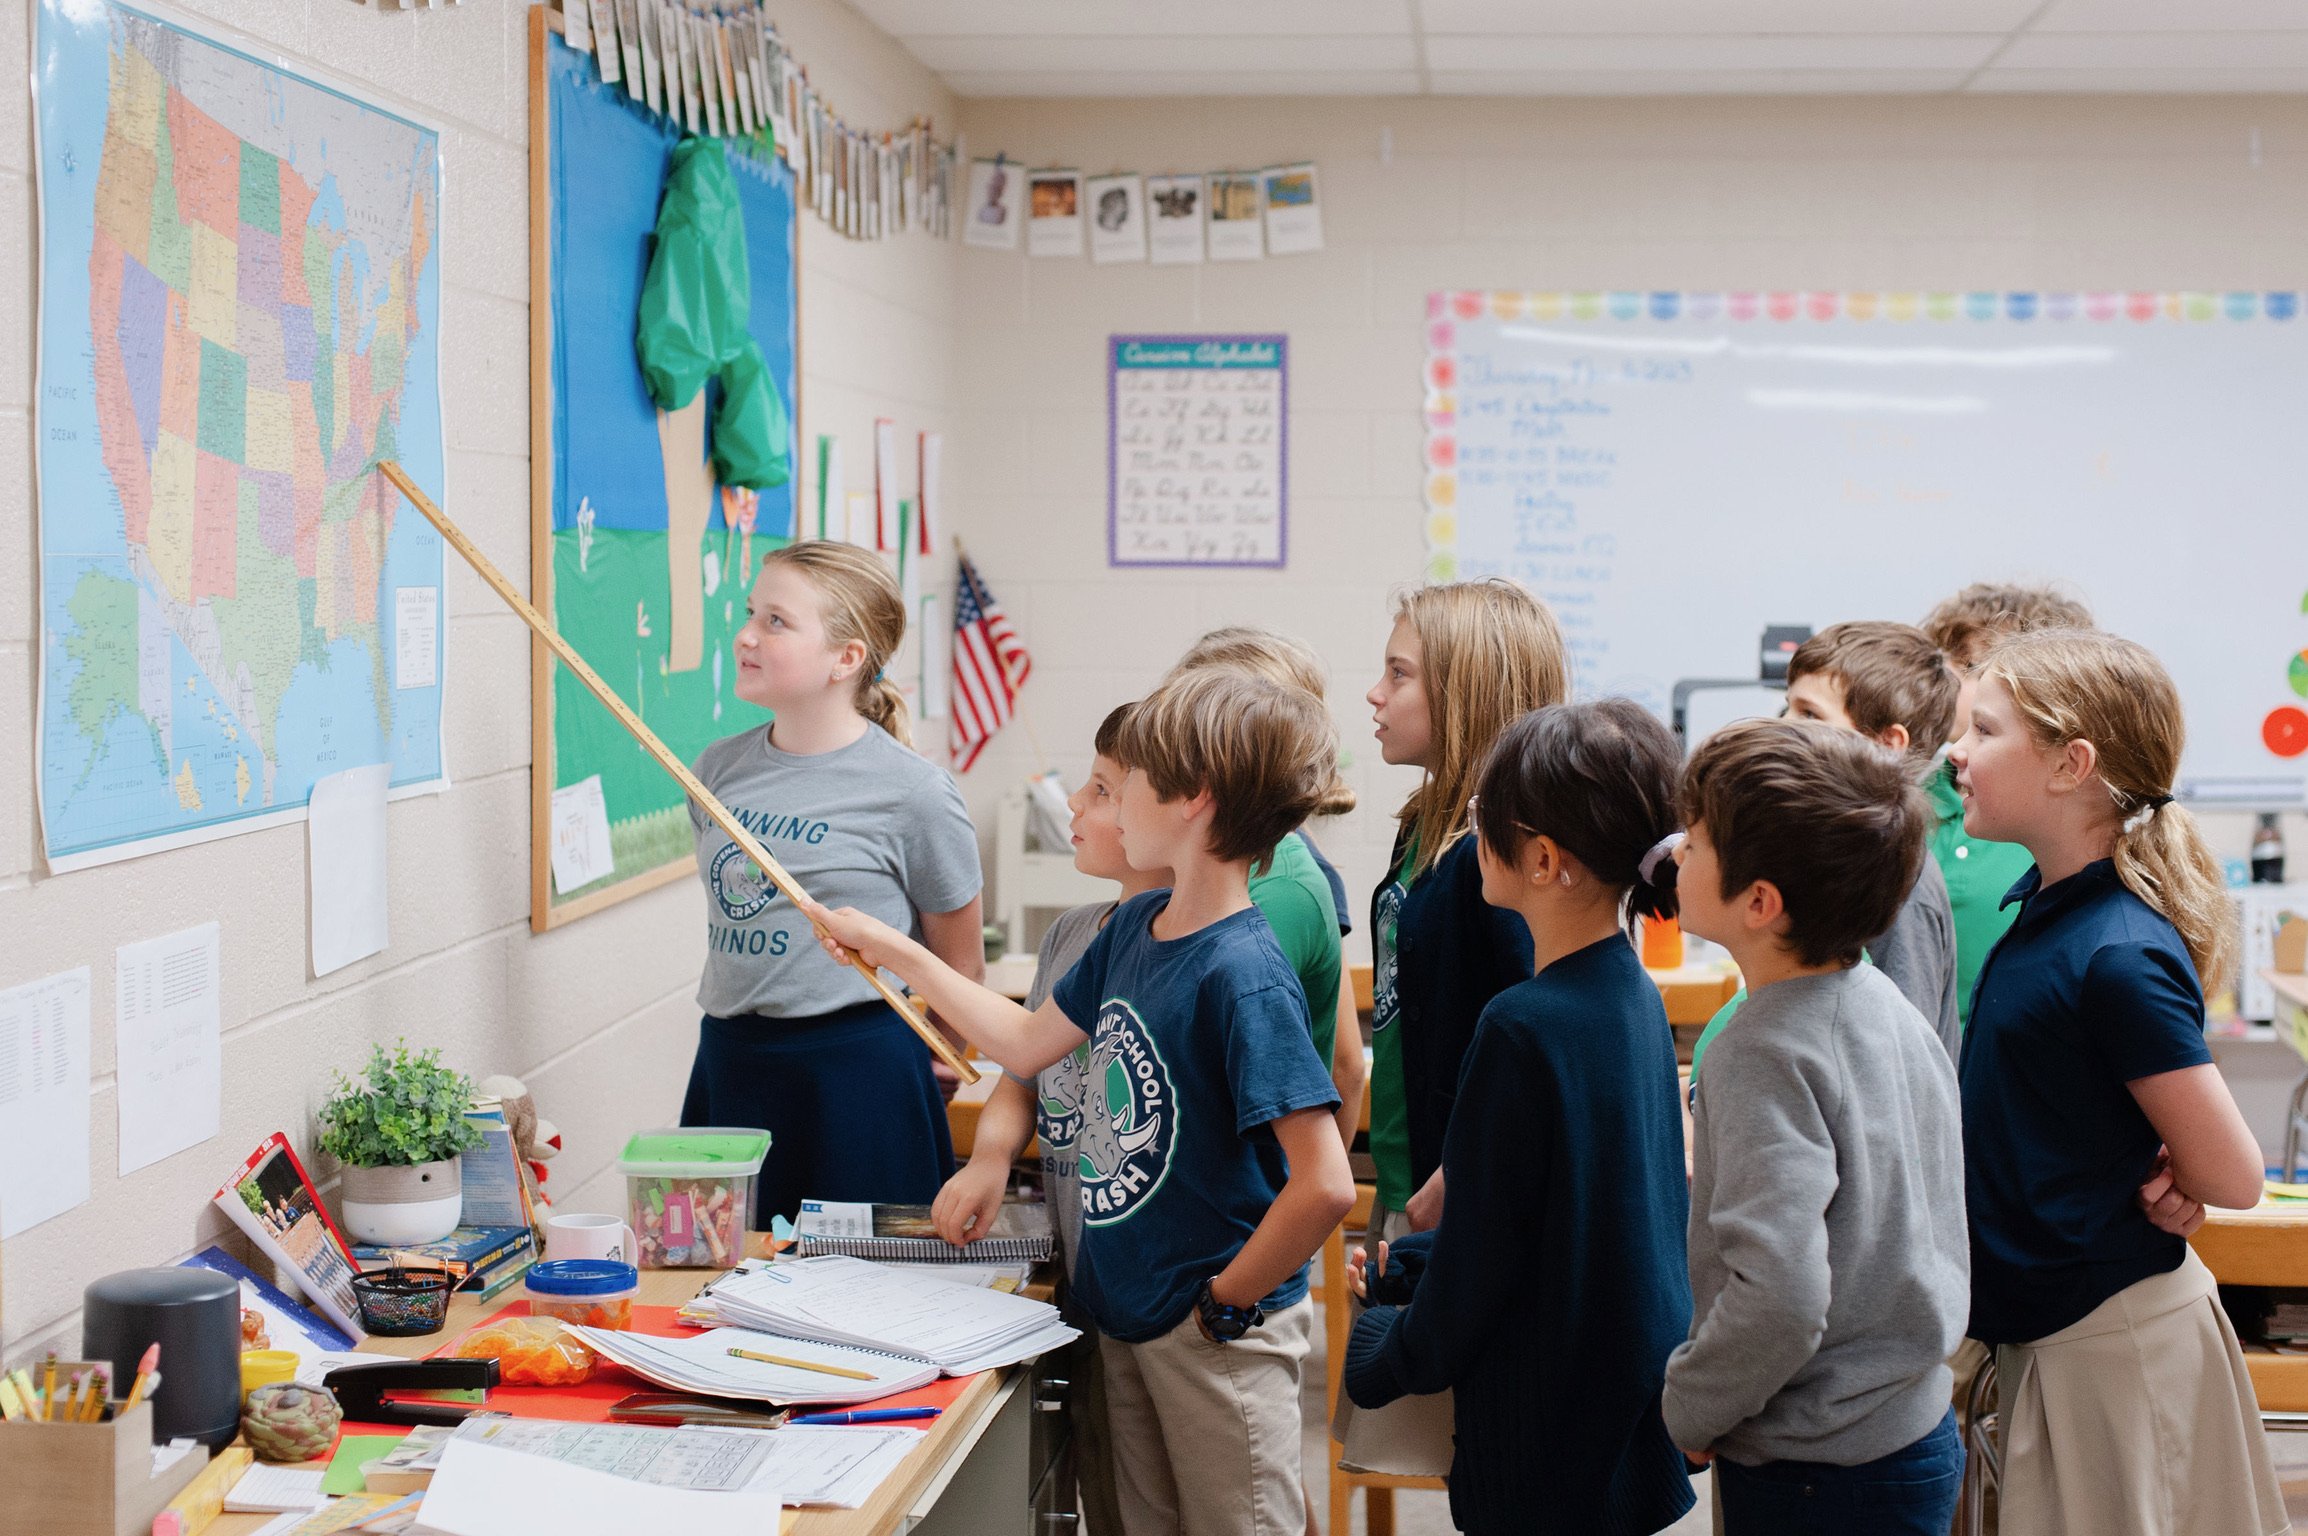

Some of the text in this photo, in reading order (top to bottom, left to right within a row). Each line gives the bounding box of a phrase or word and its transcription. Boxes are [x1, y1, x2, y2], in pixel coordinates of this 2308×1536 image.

[50, 427, 77, 441] OCEAN
[705, 805, 829, 844] NNING
[712, 844, 738, 879] COVENA
[730, 894, 770, 918] CRASH
[1373, 986, 1399, 1022] ASH
